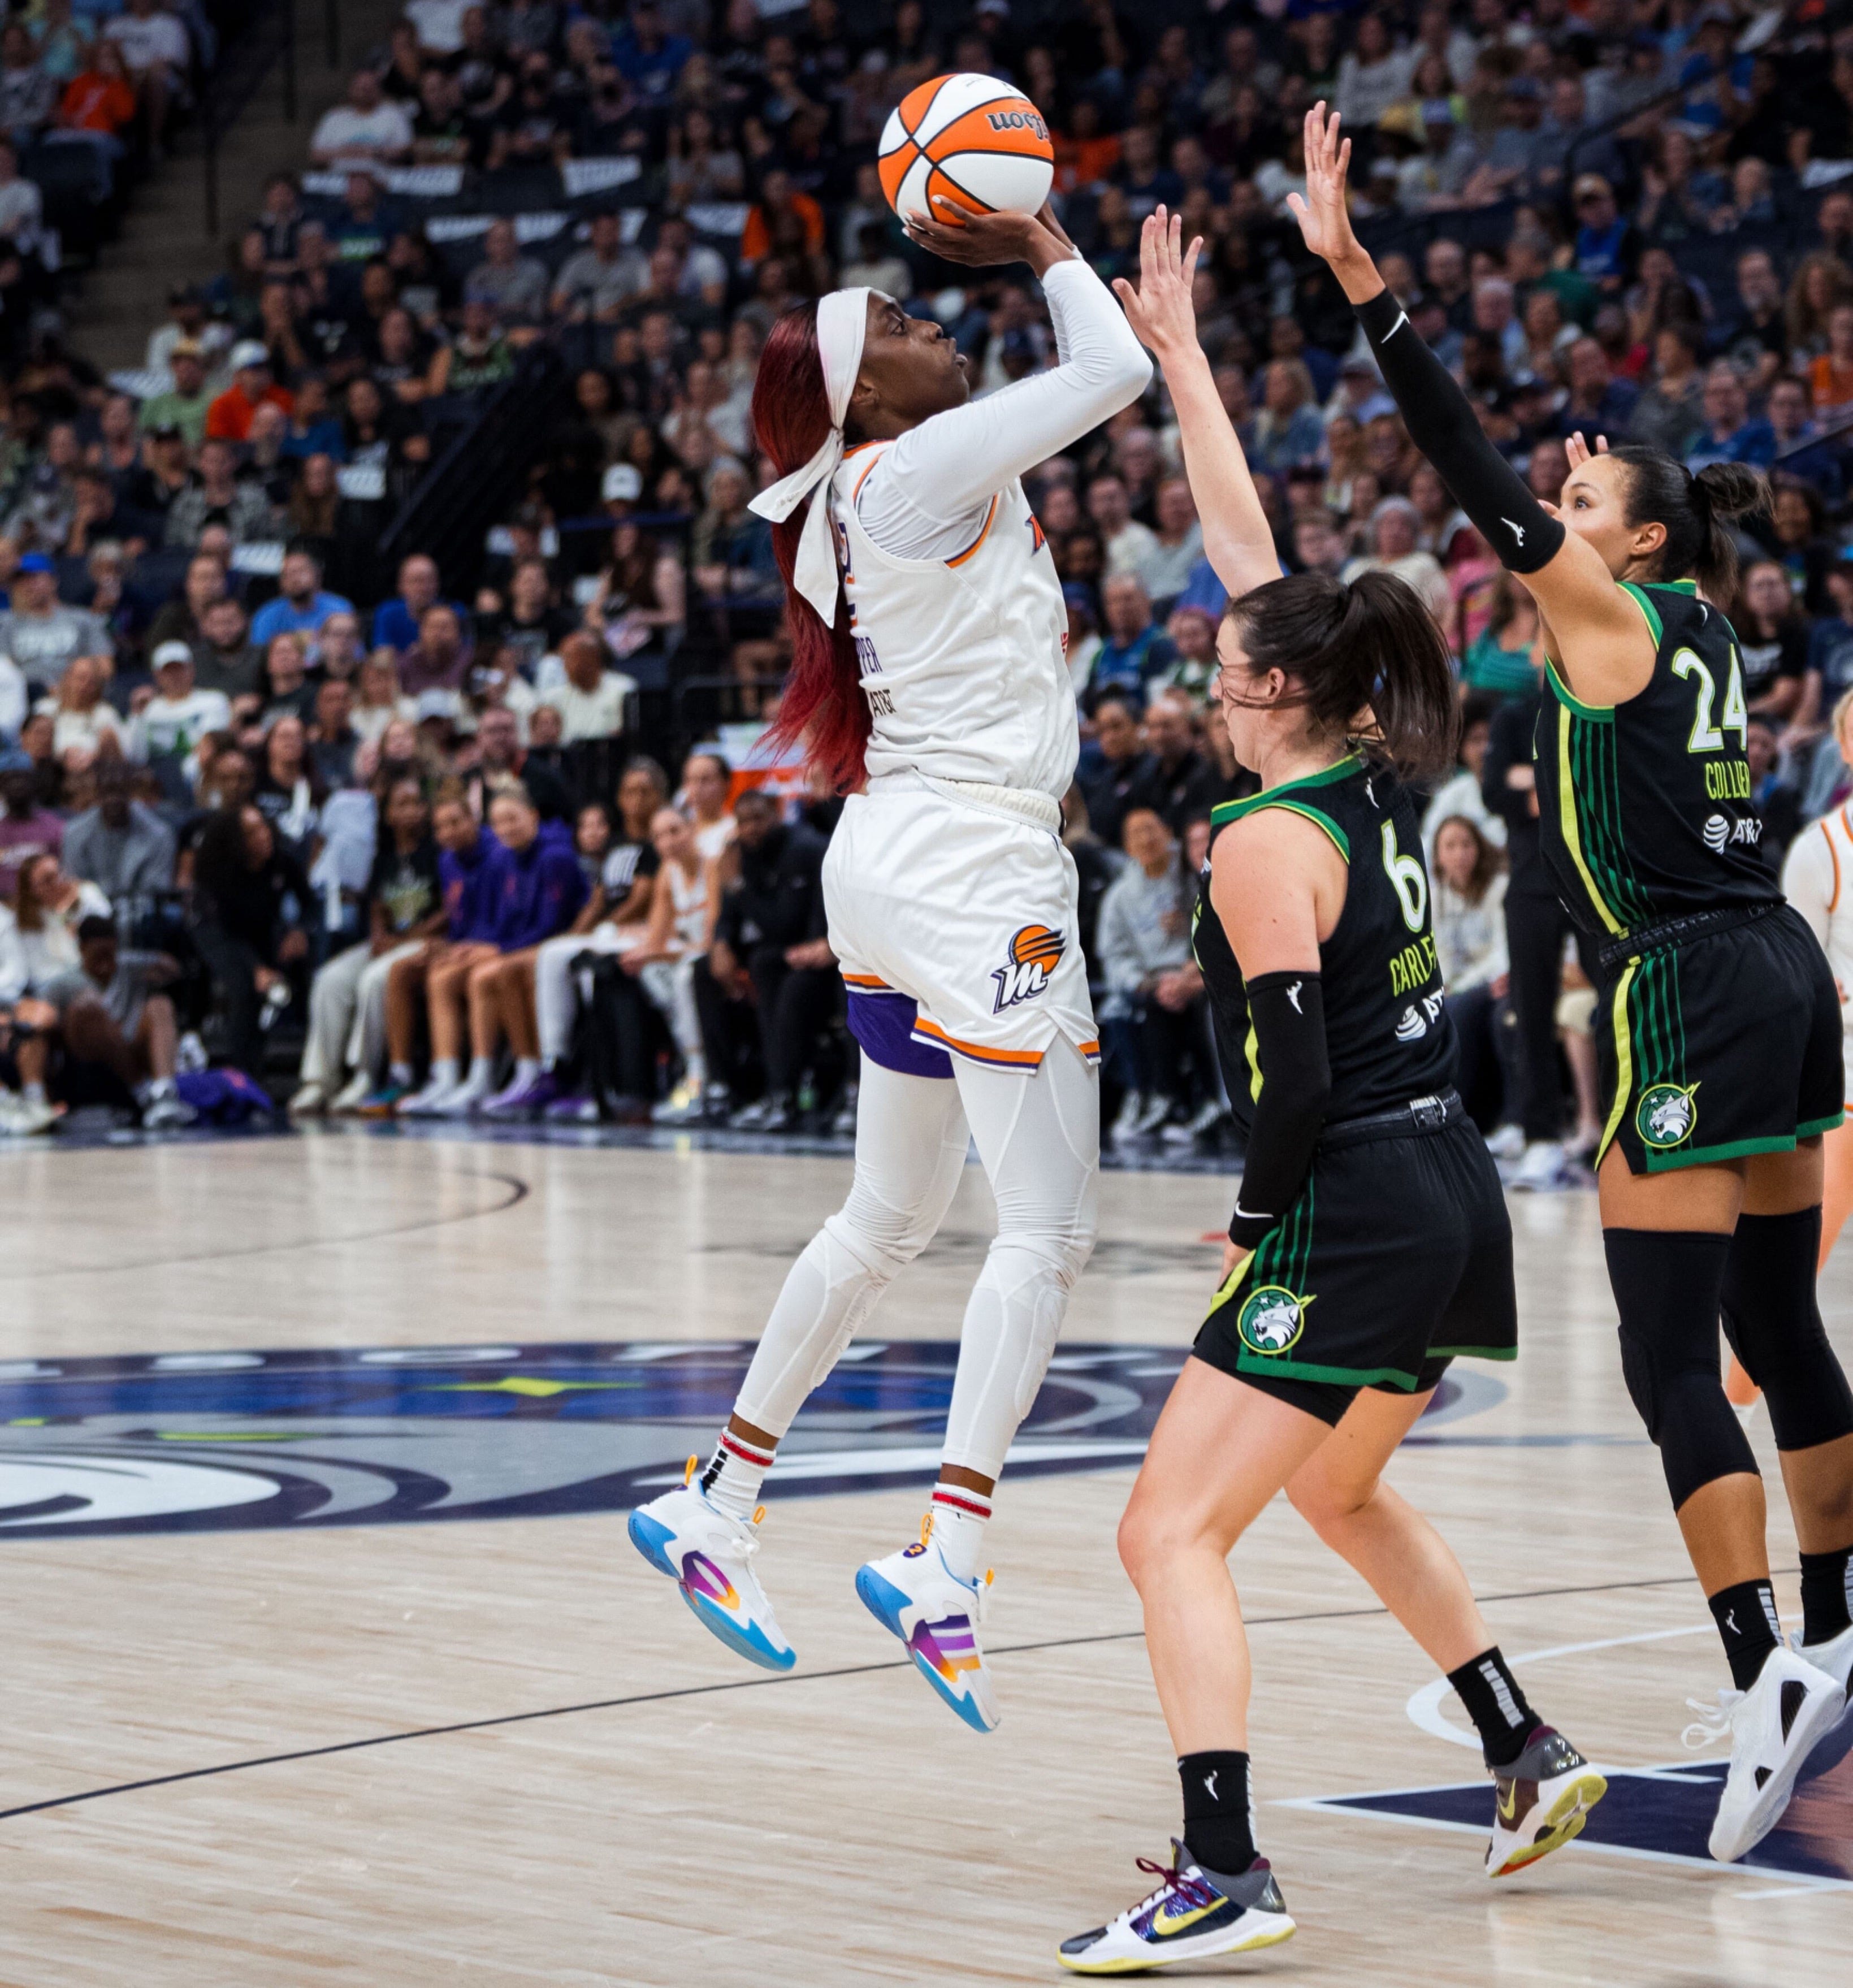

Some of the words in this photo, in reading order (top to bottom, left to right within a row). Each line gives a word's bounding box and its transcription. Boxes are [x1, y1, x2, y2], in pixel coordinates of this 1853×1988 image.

[986, 111, 1049, 140] ilson
[1672, 643, 1748, 754] 24
[1380, 818, 1426, 933] 6
